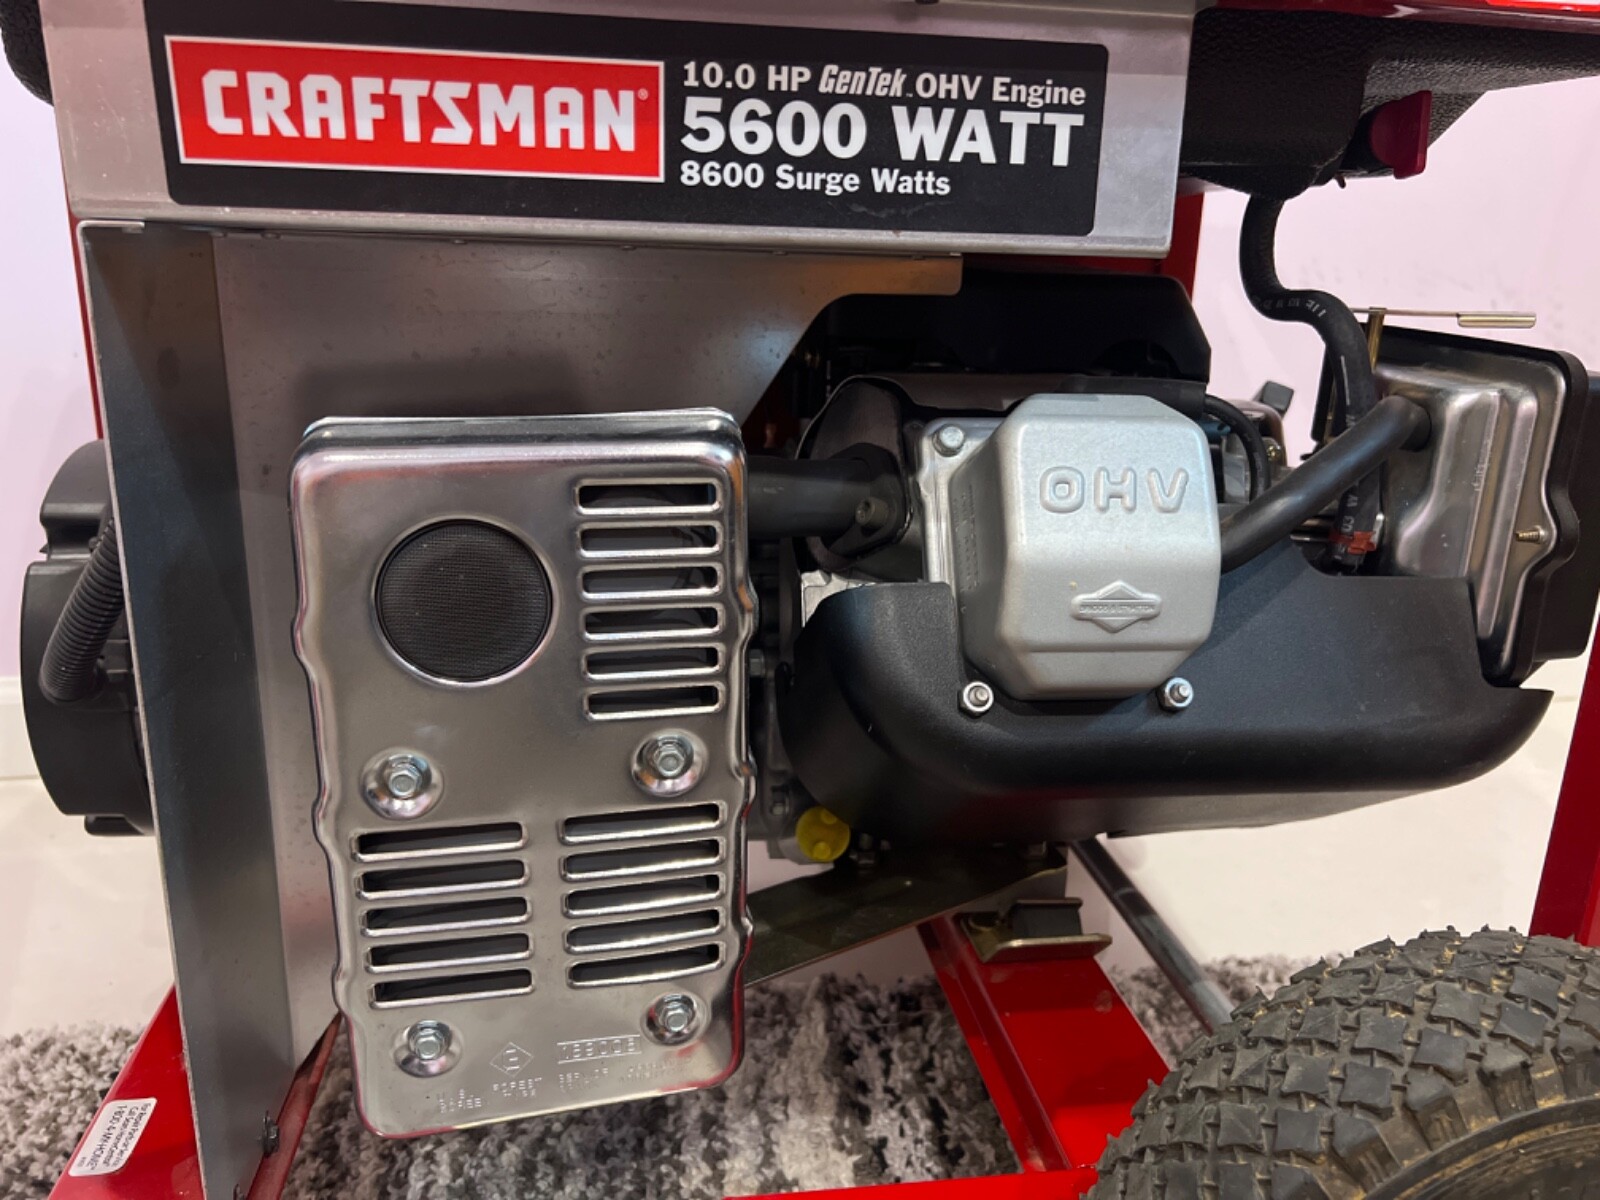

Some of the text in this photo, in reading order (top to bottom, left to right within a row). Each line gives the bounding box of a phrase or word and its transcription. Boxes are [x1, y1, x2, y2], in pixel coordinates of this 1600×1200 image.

[683, 61, 1086, 109] 10.0 HP GenTek OHV Engine
[680, 96, 1086, 167] 5600 WATT
[680, 160, 952, 196] 8600 Surge Watts
[1039, 465, 1190, 514] OHV
